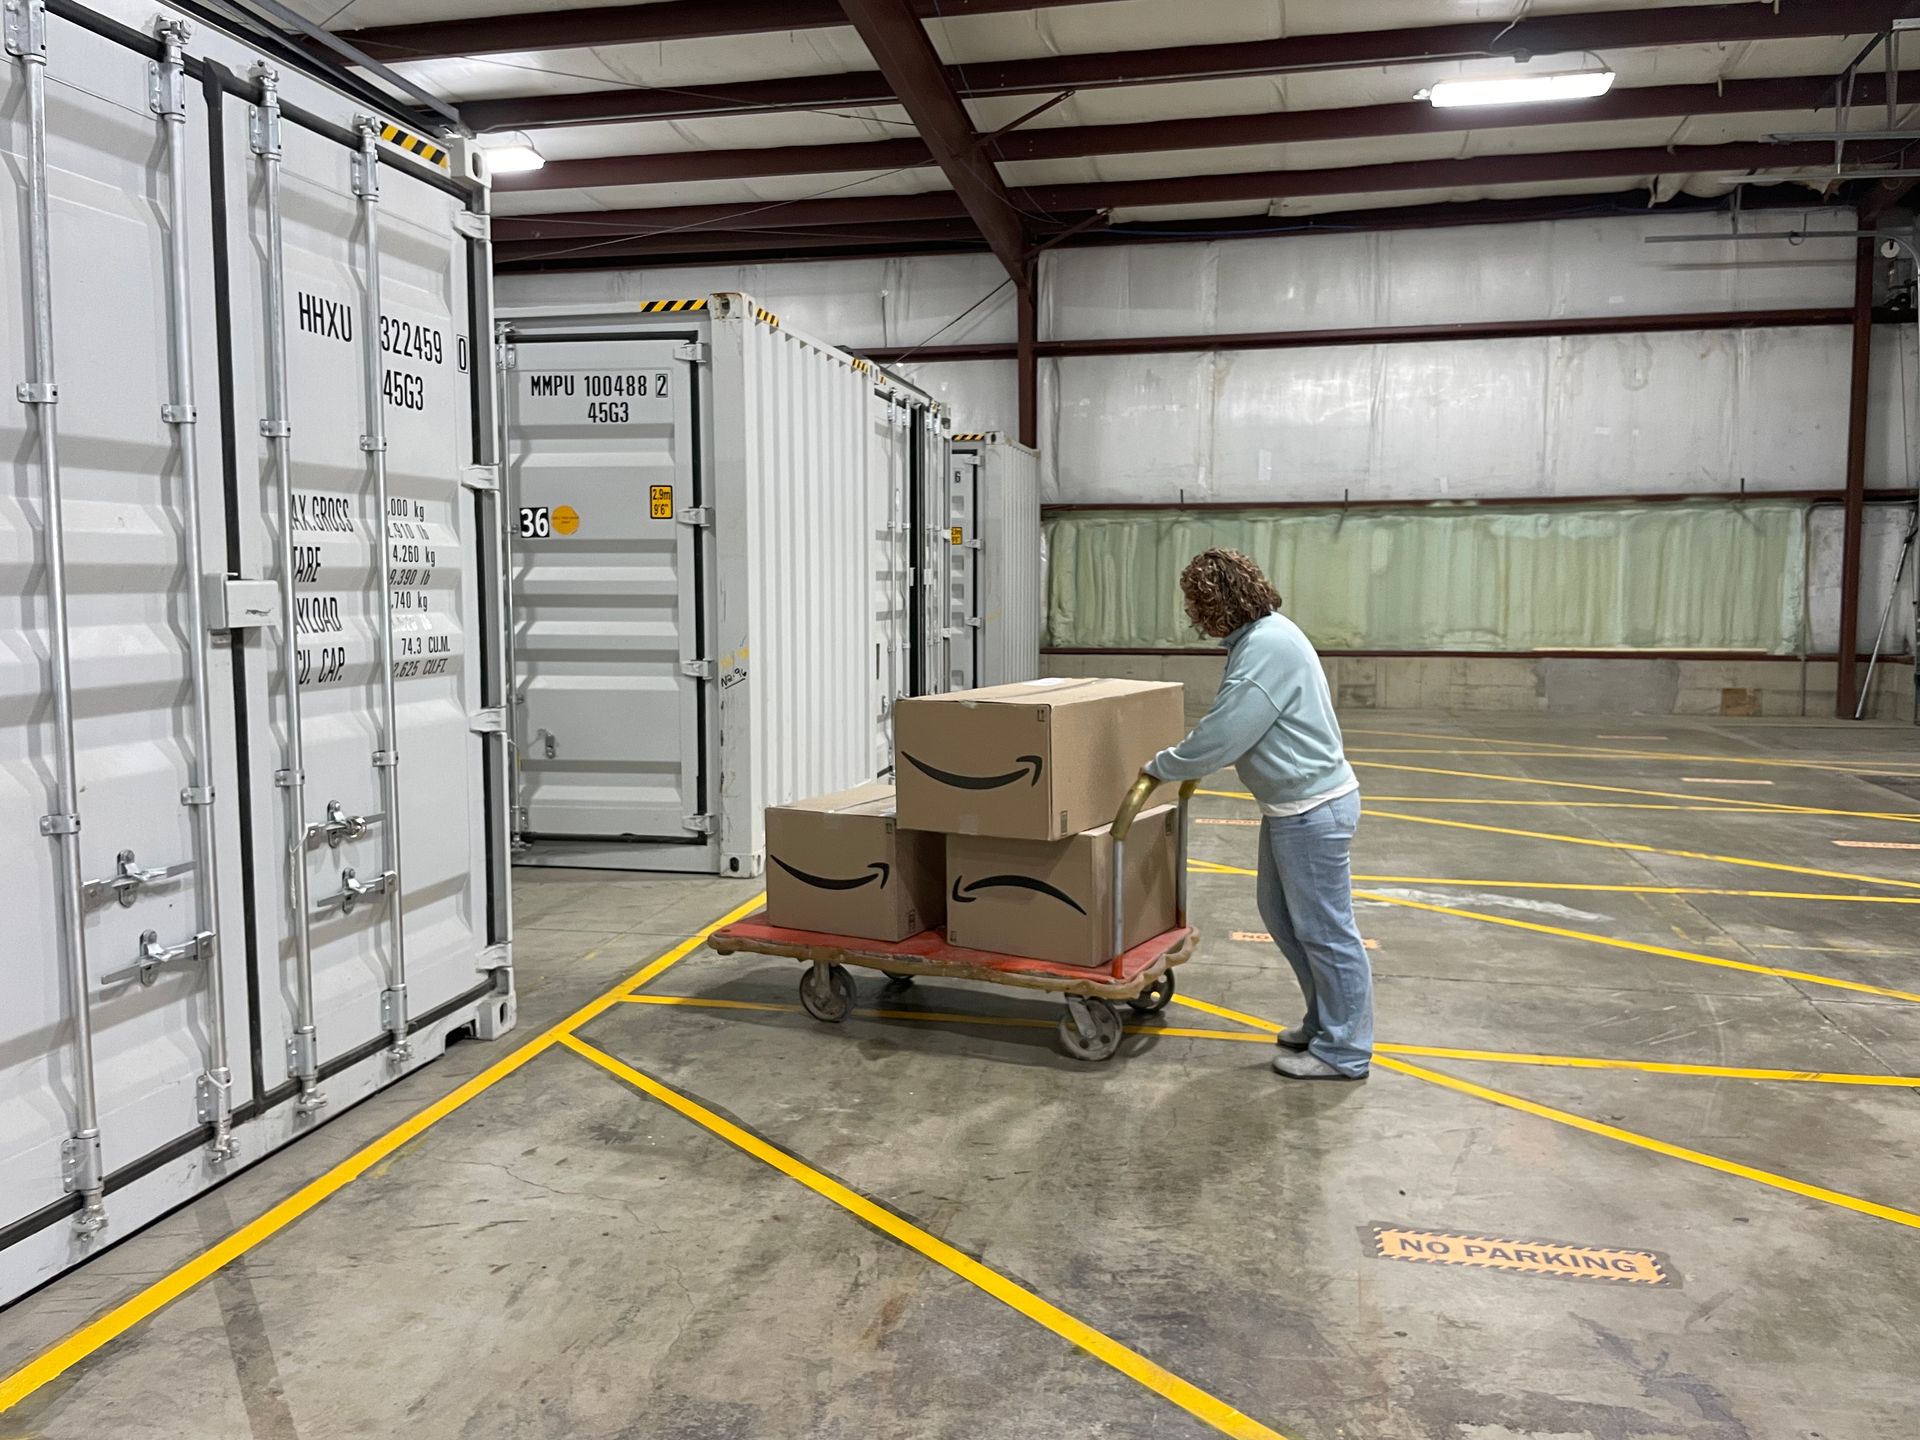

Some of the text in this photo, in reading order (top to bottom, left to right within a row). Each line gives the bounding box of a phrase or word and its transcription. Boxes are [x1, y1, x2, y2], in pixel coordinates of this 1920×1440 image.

[298, 291, 352, 342] HHXU
[381, 315, 442, 365] 322459
[383, 369, 424, 411] 45G3
[531, 375, 667, 396] MMPU 100488 2
[587, 402, 629, 423] 45G3
[291, 494, 354, 532] AX.GROSS
[414, 500, 424, 522] kg
[520, 508, 549, 537] 36
[293, 546, 321, 583] TARE
[425, 545, 436, 567] kg
[296, 597, 343, 634] YLOAD
[418, 591, 428, 612] kg
[401, 637, 422, 655] 74.3
[1399, 1238, 1639, 1273] NO PARKING
